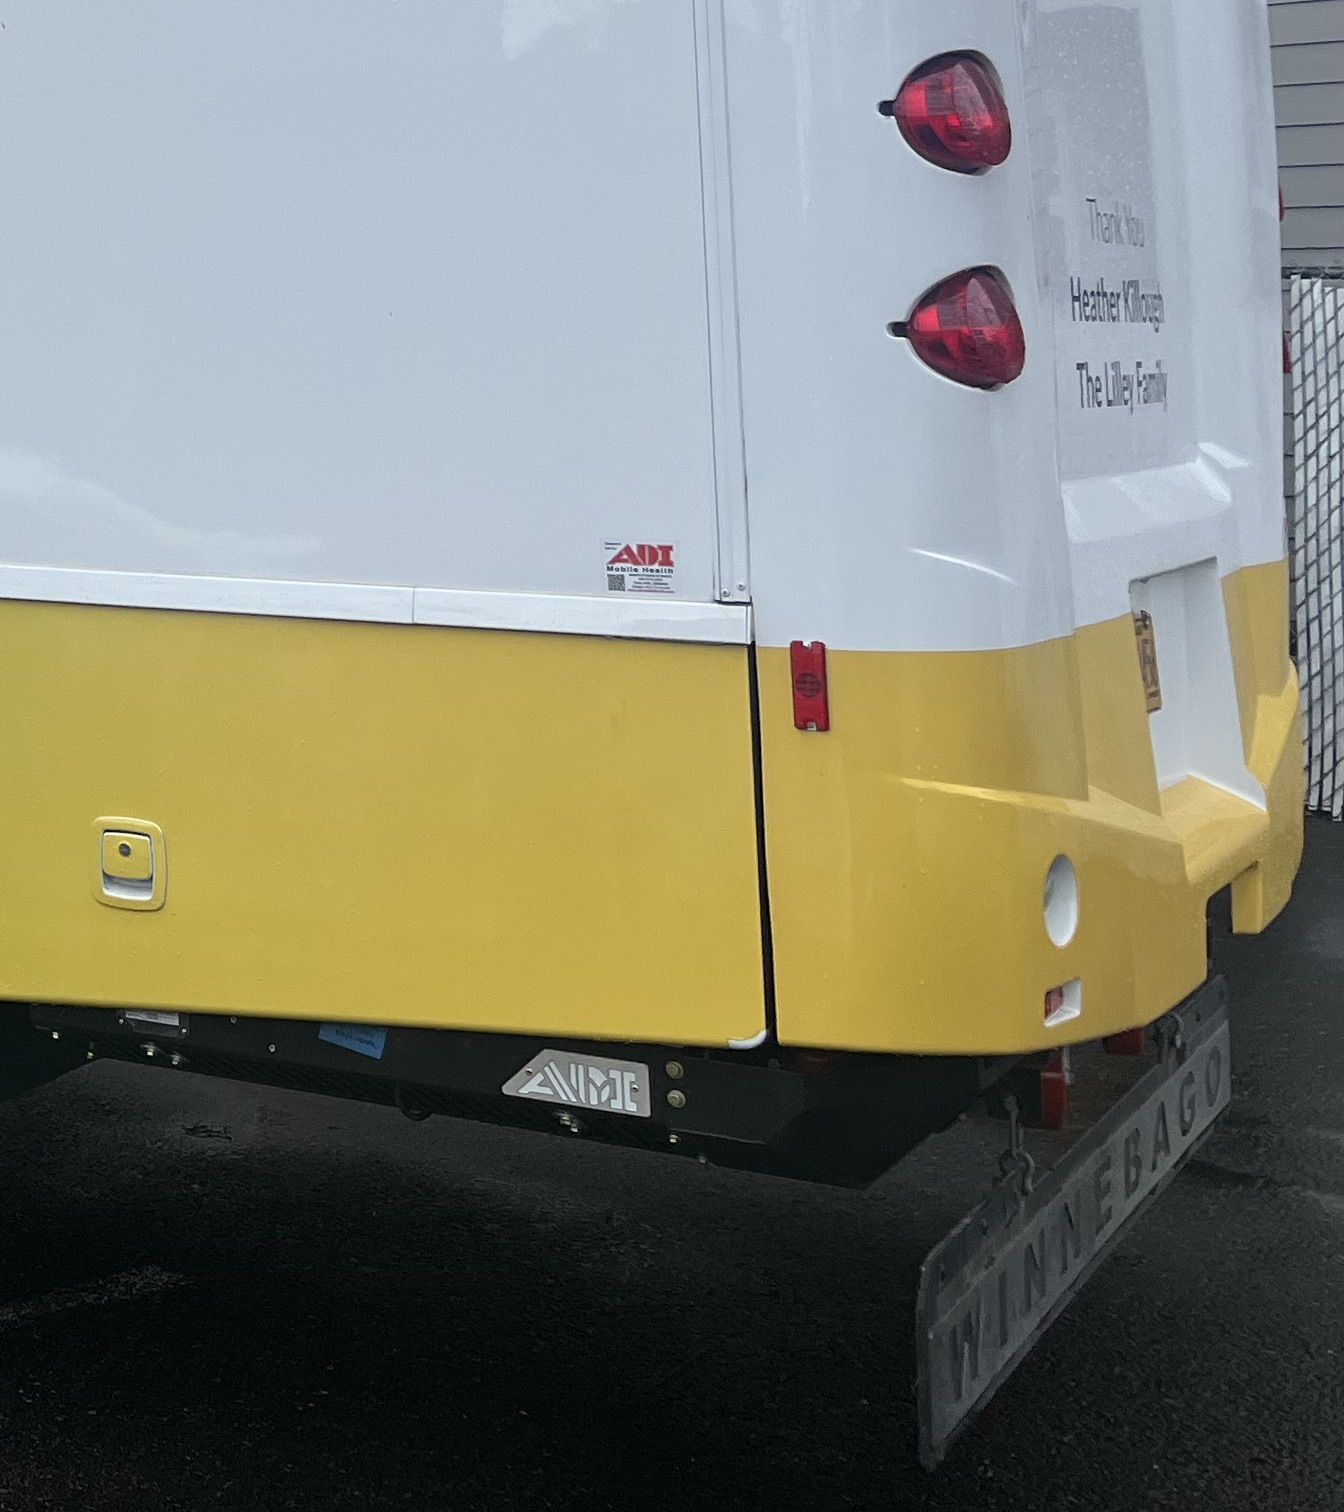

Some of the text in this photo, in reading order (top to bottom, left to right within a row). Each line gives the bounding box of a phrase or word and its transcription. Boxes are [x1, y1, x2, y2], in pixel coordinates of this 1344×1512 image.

[1070, 276, 1121, 323] Heather
[1076, 361, 1102, 409] The
[607, 543, 675, 567] ADI
[607, 565, 639, 573] Mobile
[947, 1044, 1223, 1402] WINNEBAGO
